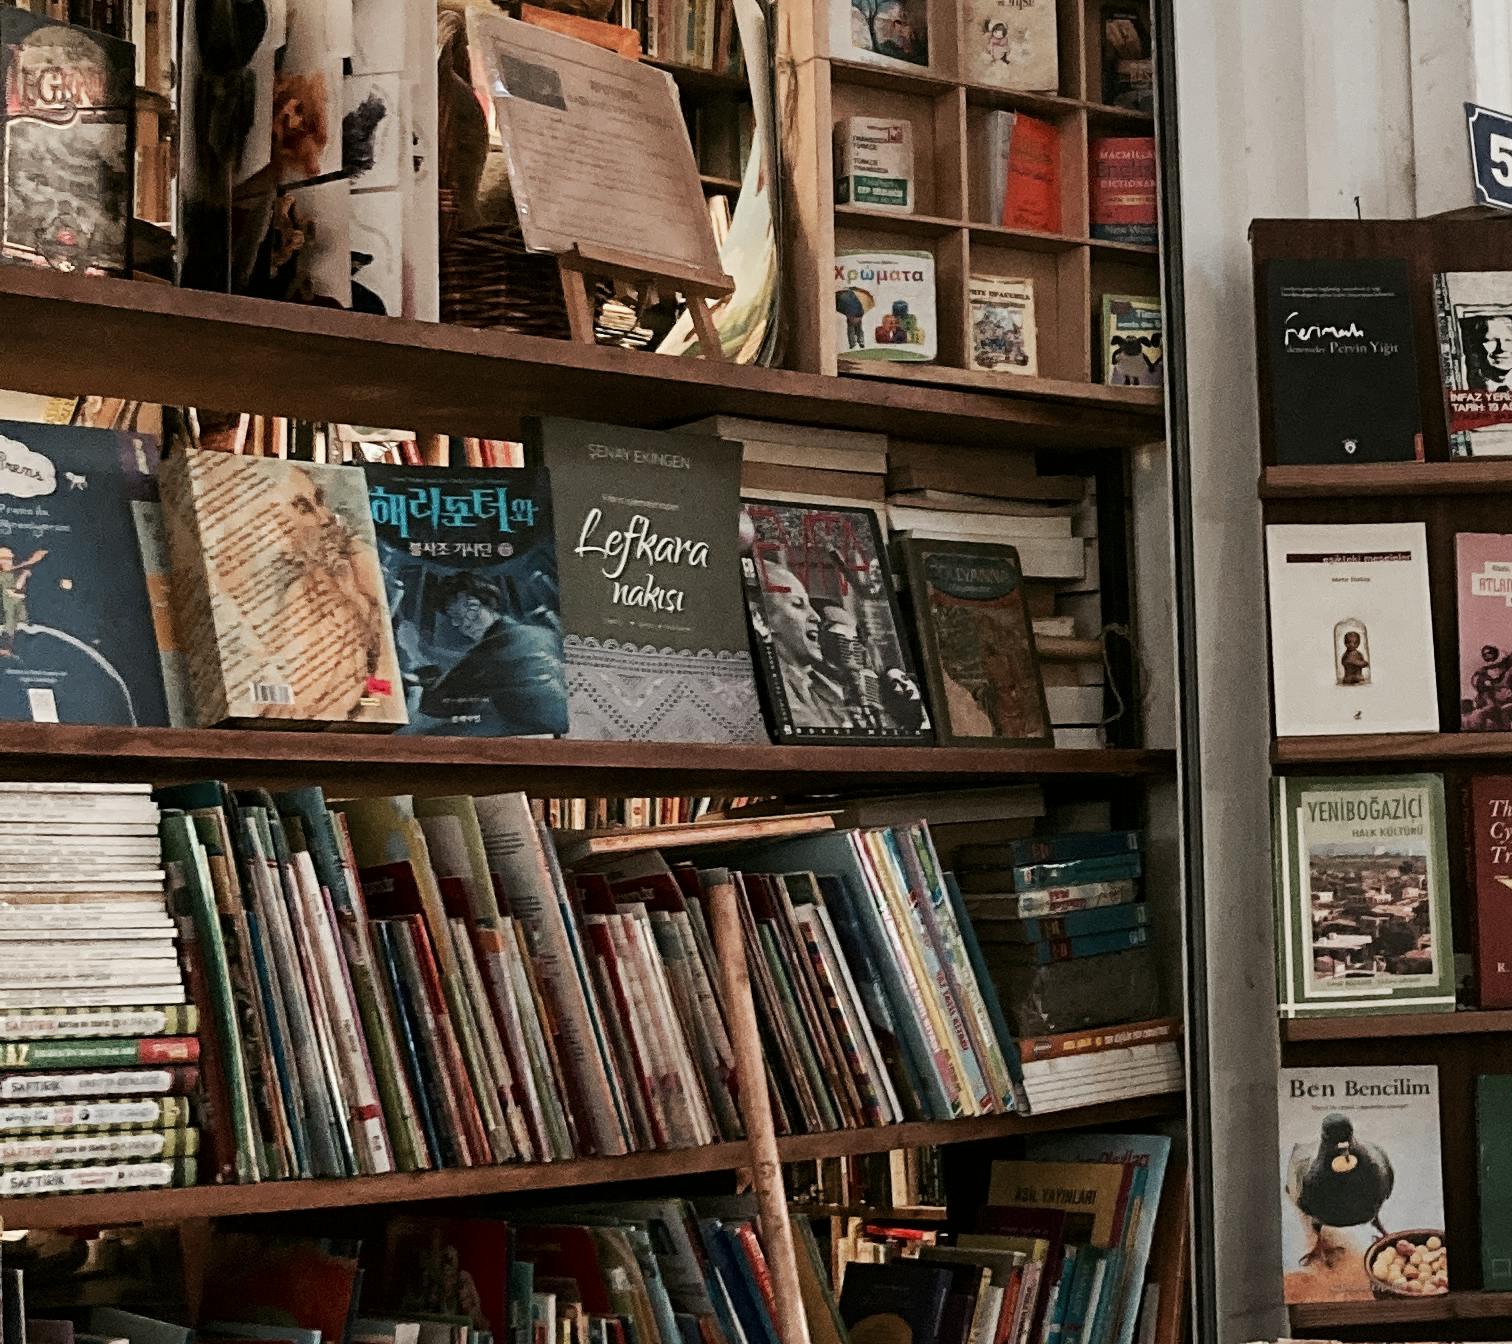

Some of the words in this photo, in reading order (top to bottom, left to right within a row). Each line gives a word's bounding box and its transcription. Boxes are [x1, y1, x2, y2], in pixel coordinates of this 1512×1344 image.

[833, 263, 924, 285] Χρώματα
[1330, 341, 1367, 355] Pervin
[573, 507, 710, 579] Lefkara
[1307, 793, 1423, 824] YENİBOĞAZİÇİ
[1289, 1079, 1335, 1099] Ben
[1344, 1077, 1431, 1097] Bencilim
